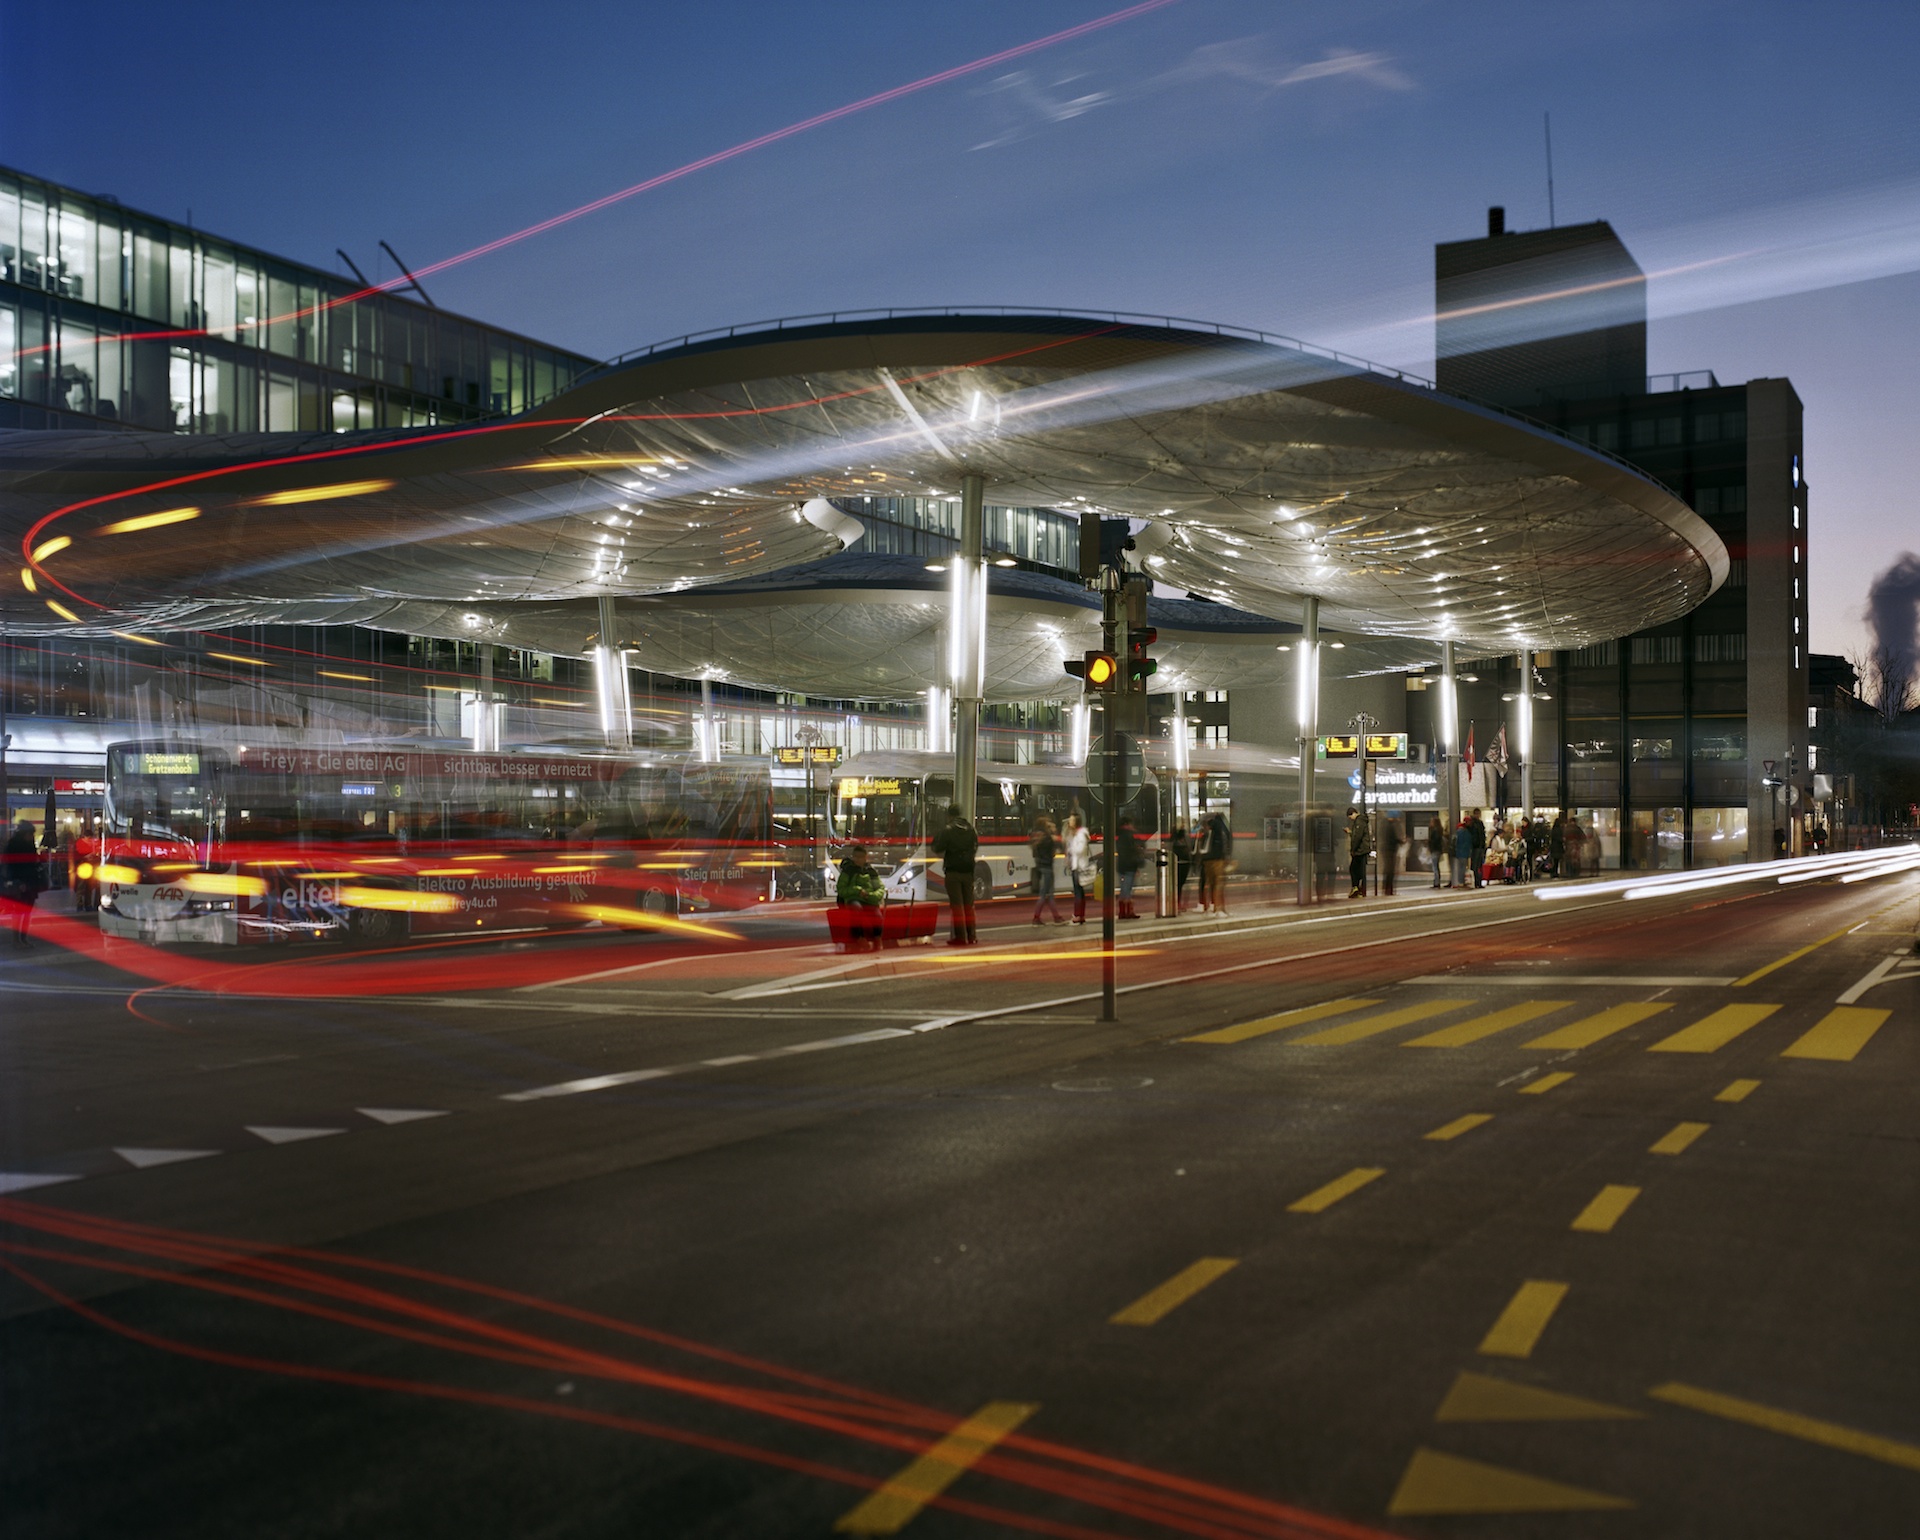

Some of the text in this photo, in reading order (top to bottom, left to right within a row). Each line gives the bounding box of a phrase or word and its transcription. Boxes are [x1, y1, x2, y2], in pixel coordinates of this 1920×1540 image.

[1319, 743, 1325, 752] D
[1399, 742, 1405, 751] E
[128, 756, 134, 772] 3
[262, 752, 405, 773] Frey + Cie eltel AG
[444, 757, 592, 777] sichtbar besser vernetzt
[1406, 773, 1437, 784] Hotel
[394, 784, 401, 798] 3
[1352, 788, 1437, 804] Aarauerhof
[417, 871, 597, 892] Elektro Ausbildung gesucht?
[684, 867, 744, 882] Steig mit ein!
[153, 887, 184, 901] AAR
[282, 879, 340, 908] eltel
